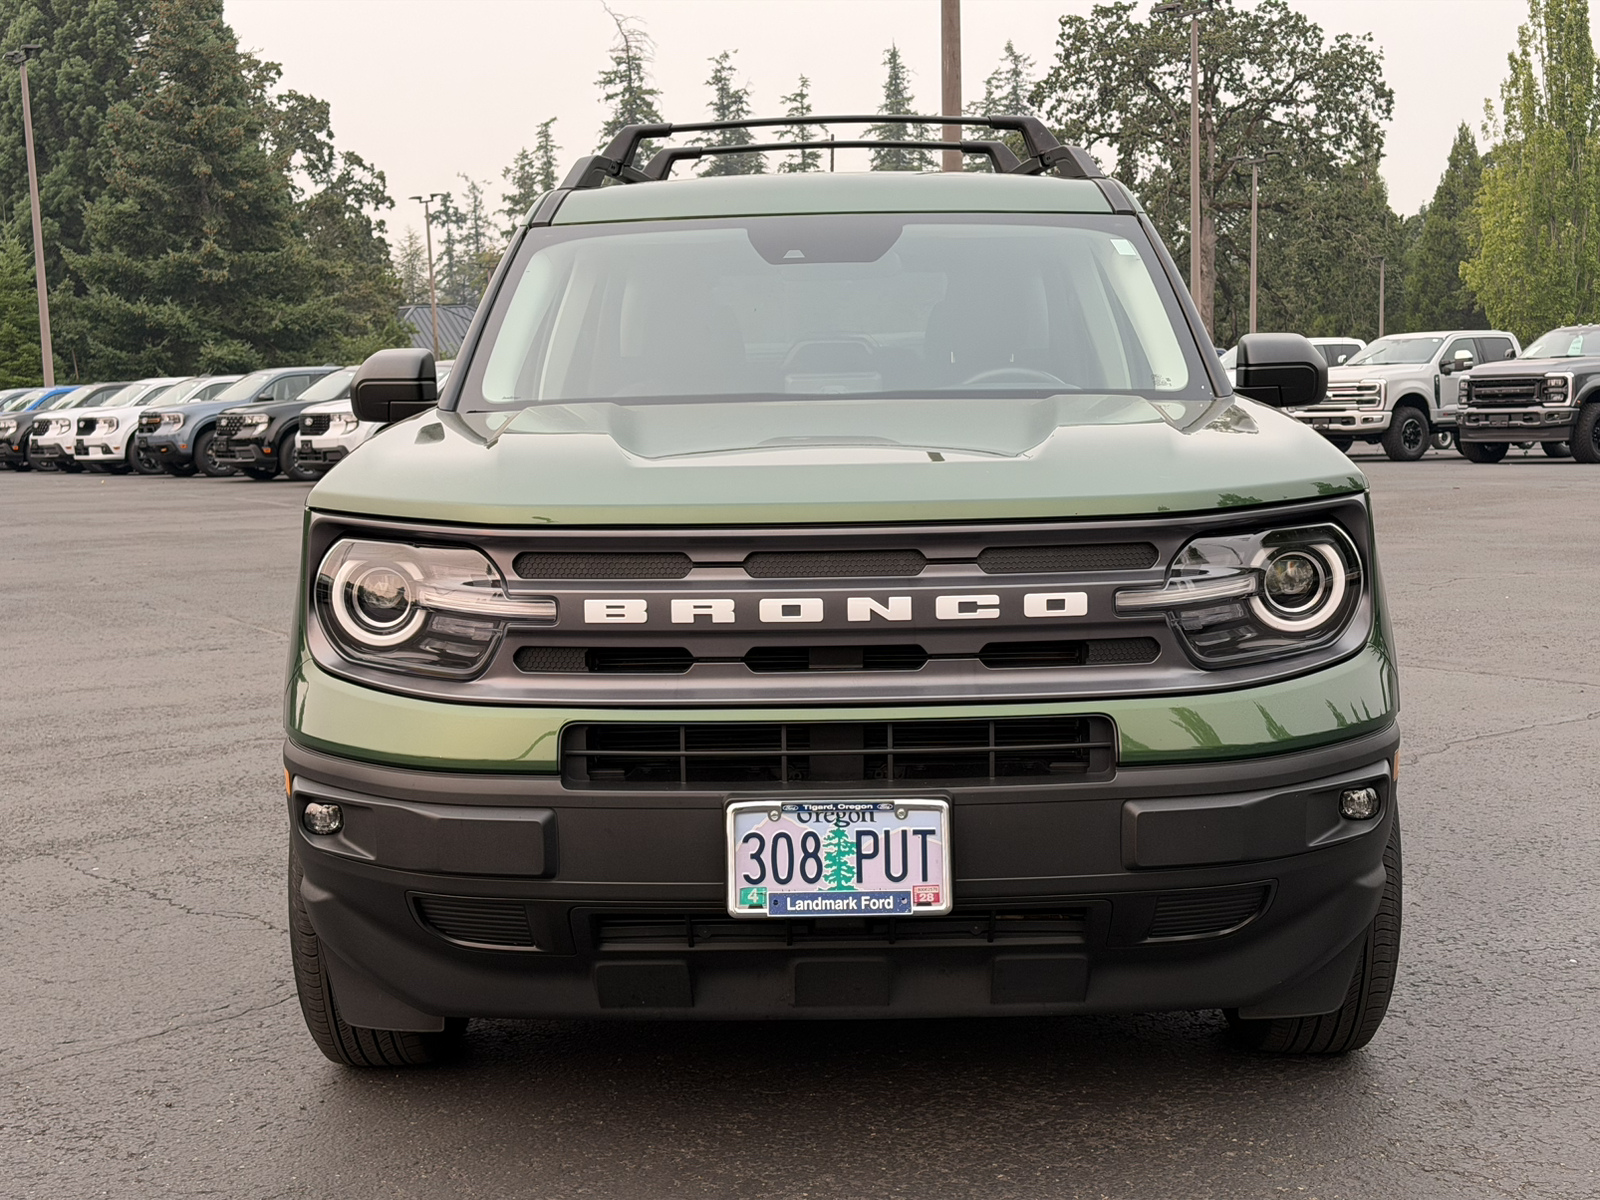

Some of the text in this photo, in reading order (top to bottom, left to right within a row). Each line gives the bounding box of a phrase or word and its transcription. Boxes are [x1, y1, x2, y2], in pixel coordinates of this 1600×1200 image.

[583, 591, 1089, 624] BRONCO
[802, 803, 836, 811] Tigard,
[796, 811, 877, 828] Oregon
[742, 829, 936, 885] 308 PUT
[747, 887, 759, 904] 4
[786, 895, 894, 911] Landmark Ford
[918, 892, 935, 902] 28
